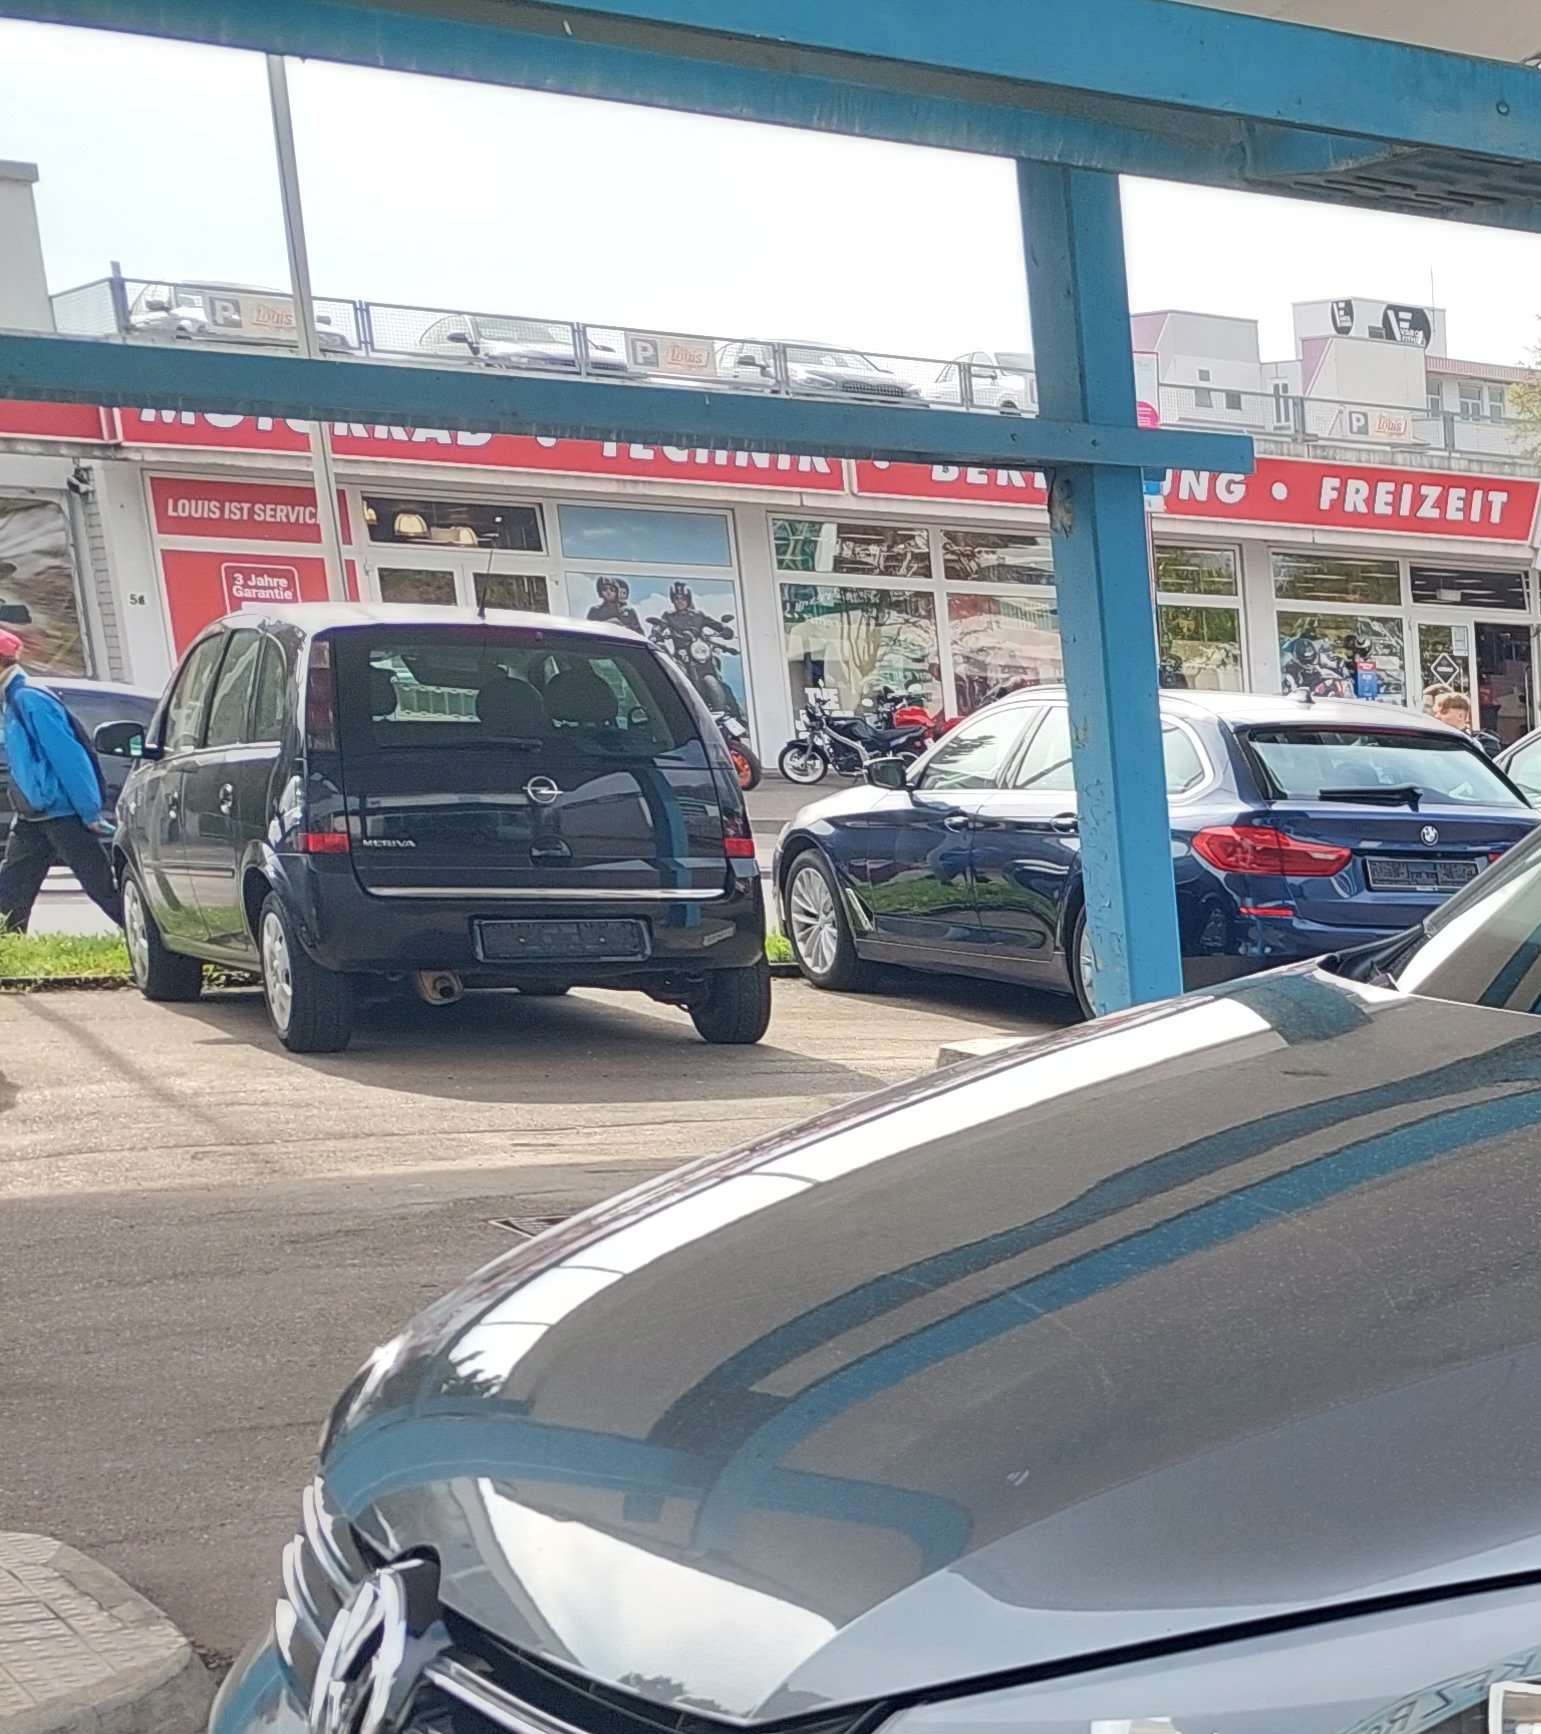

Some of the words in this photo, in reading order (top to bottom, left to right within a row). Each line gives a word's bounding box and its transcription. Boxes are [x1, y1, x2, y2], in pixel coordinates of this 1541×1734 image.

[1319, 476, 1509, 524] FREIZEIT
[167, 498, 221, 519] LOUIS
[224, 500, 250, 521] IST
[253, 502, 320, 525] SERVIC
[232, 573, 243, 587] 3
[247, 573, 289, 588] Jahre
[232, 584, 293, 601] Garantie
